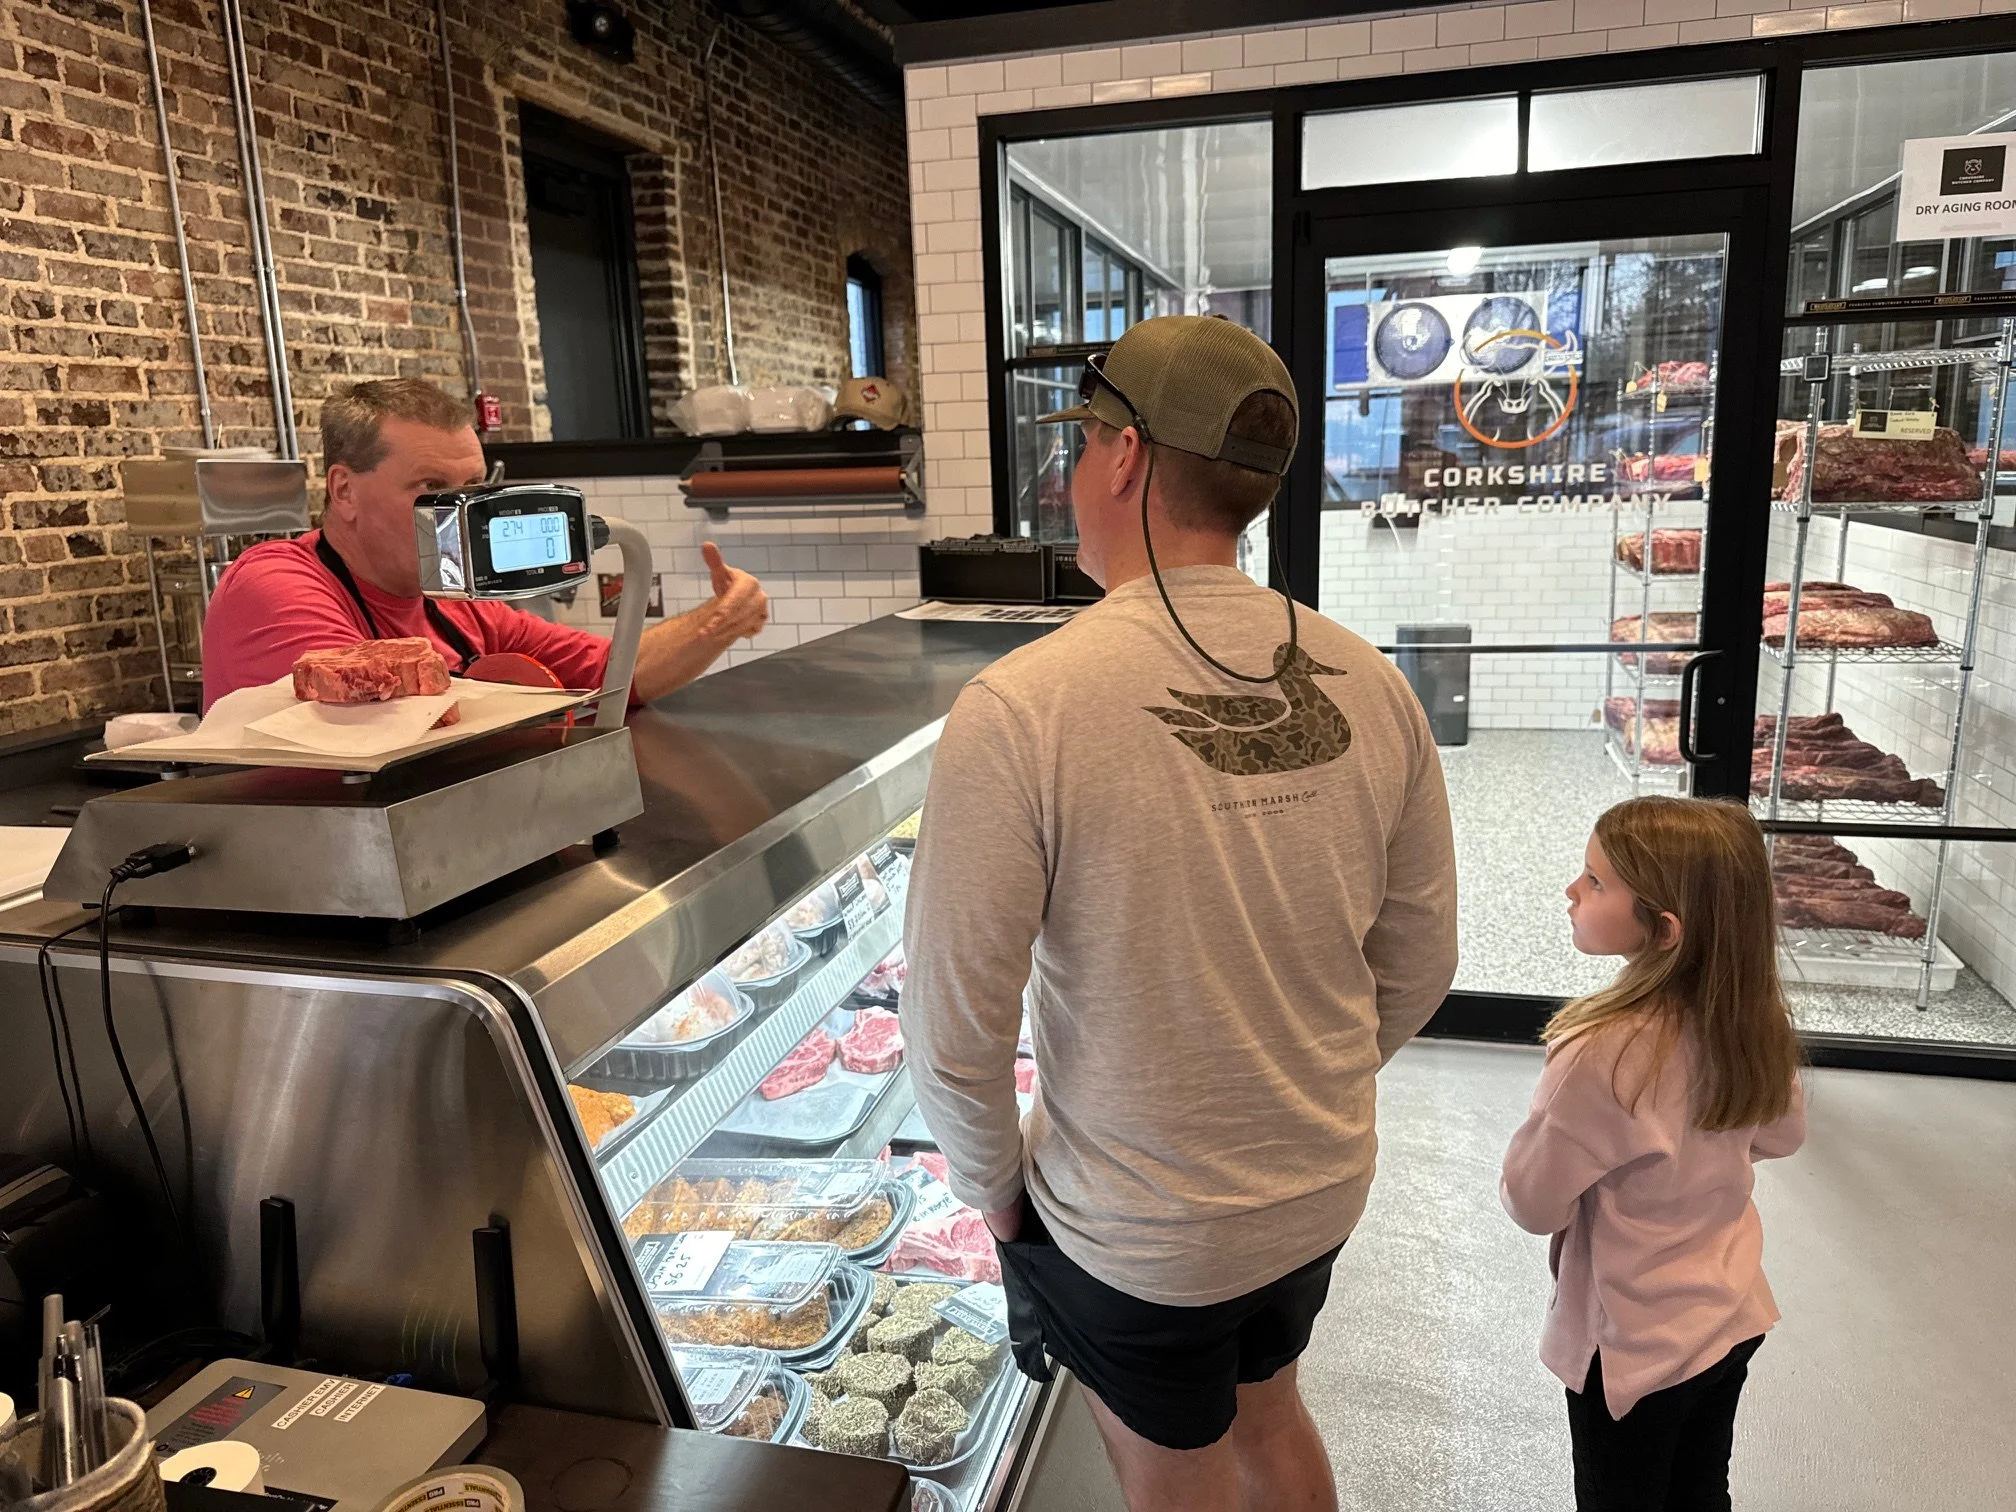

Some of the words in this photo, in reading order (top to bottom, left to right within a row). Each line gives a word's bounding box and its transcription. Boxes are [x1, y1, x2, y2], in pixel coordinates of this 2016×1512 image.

[1915, 204, 1940, 215] DRY
[1942, 202, 1981, 213] AGING
[1423, 462, 1608, 488] CORKSHIRE
[1360, 496, 1501, 519] BUTCHER
[1517, 492, 1673, 515] COMPANY
[1260, 793, 1299, 806] MARSH
[276, 1395, 319, 1428] CASHIER
[314, 1378, 336, 1396] EMV
[314, 1383, 355, 1415] CASHIER
[338, 1385, 381, 1421] INTERNET
